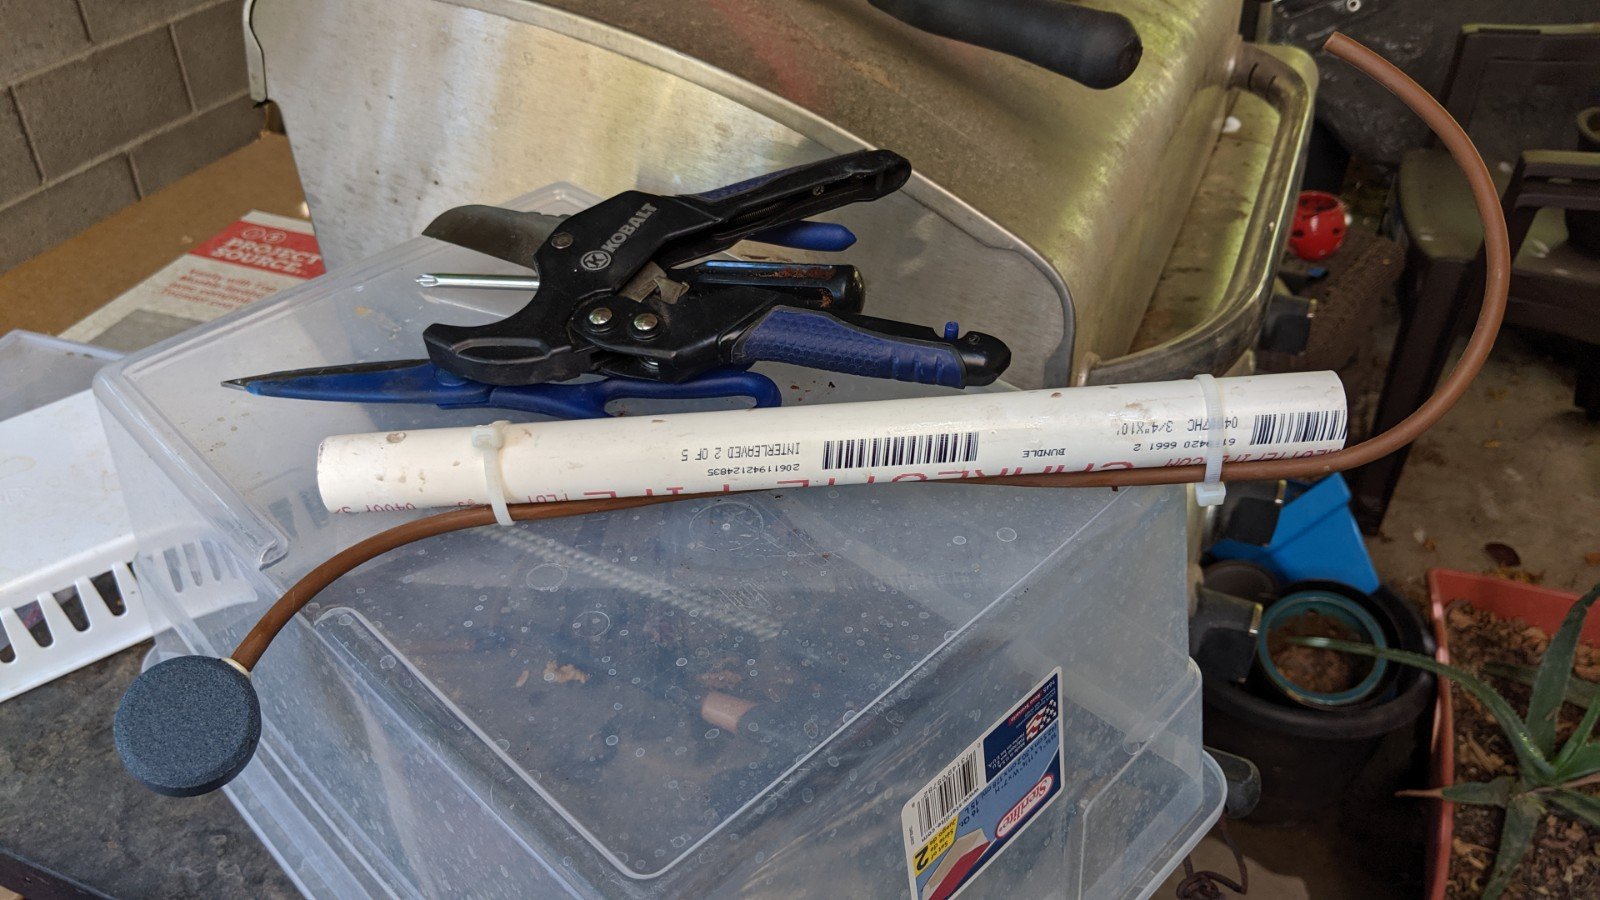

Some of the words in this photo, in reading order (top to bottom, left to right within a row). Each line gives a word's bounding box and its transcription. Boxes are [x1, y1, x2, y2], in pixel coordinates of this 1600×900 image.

[601, 203, 657, 253] KOBALT
[224, 237, 322, 265] PROJECT
[1187, 416, 1238, 431] 047HC
[714, 447, 722, 459] 2
[728, 442, 800, 459] INTERLEAVED
[1022, 448, 1066, 458] BUNDLE
[1150, 441, 1177, 450] 6661
[681, 449, 688, 461] 5
[695, 448, 708, 460] OF
[708, 463, 800, 476] 20611942124835
[1002, 780, 1046, 828] Sterilite
[921, 788, 978, 842] www.sterilite.com
[915, 845, 928, 871] 2
